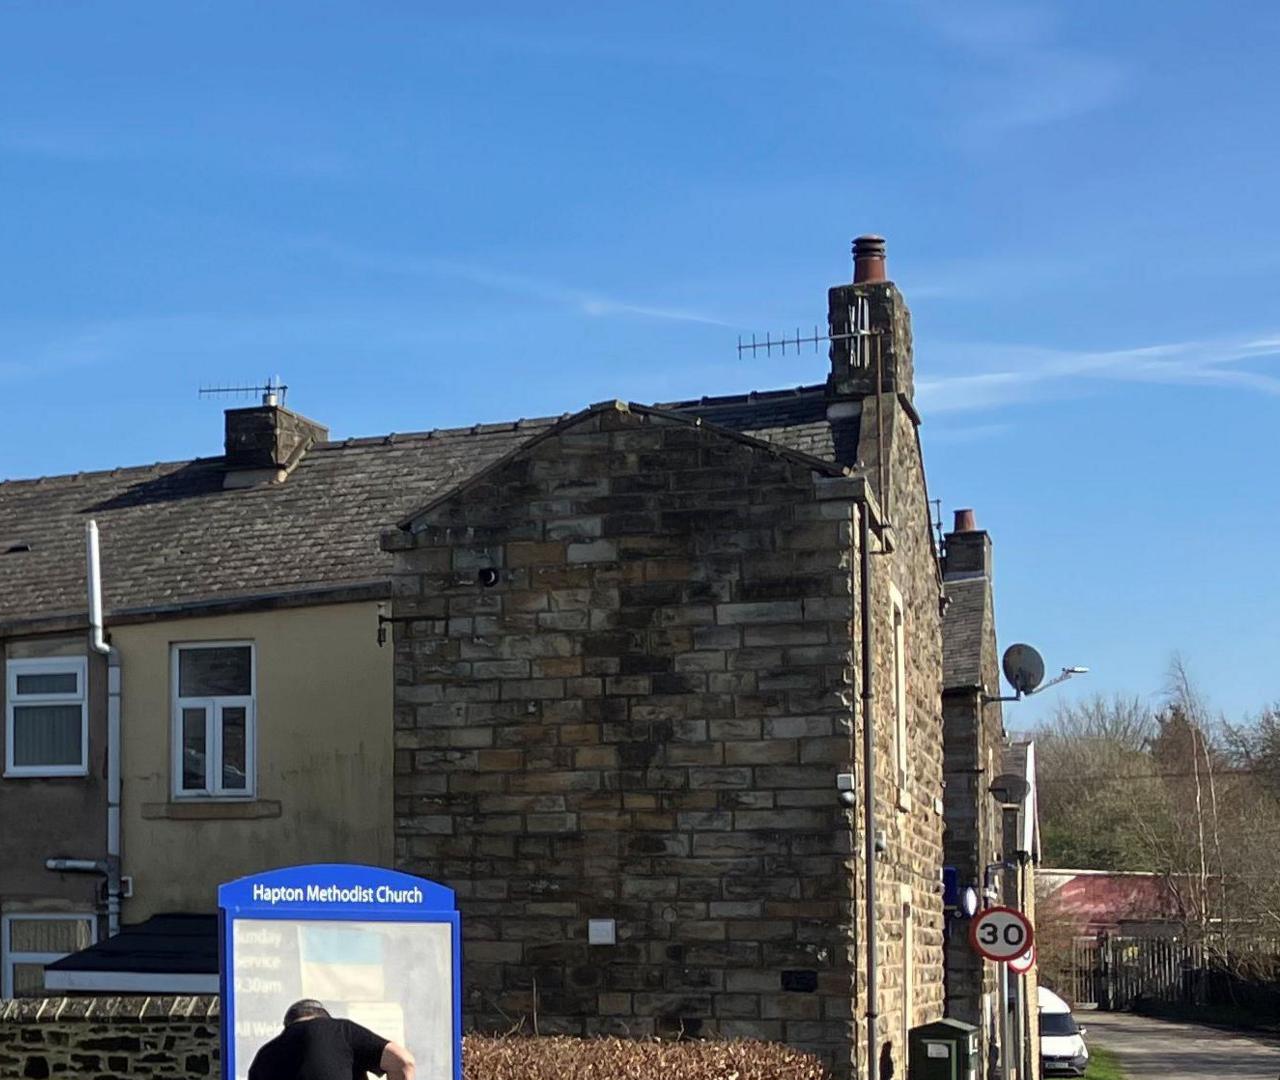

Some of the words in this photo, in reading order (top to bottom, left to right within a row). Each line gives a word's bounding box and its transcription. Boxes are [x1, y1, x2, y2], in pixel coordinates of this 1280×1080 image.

[253, 884, 304, 904] Hapton
[307, 885, 373, 903] Methodist
[376, 886, 423, 904] Church
[980, 922, 1024, 945] 30
